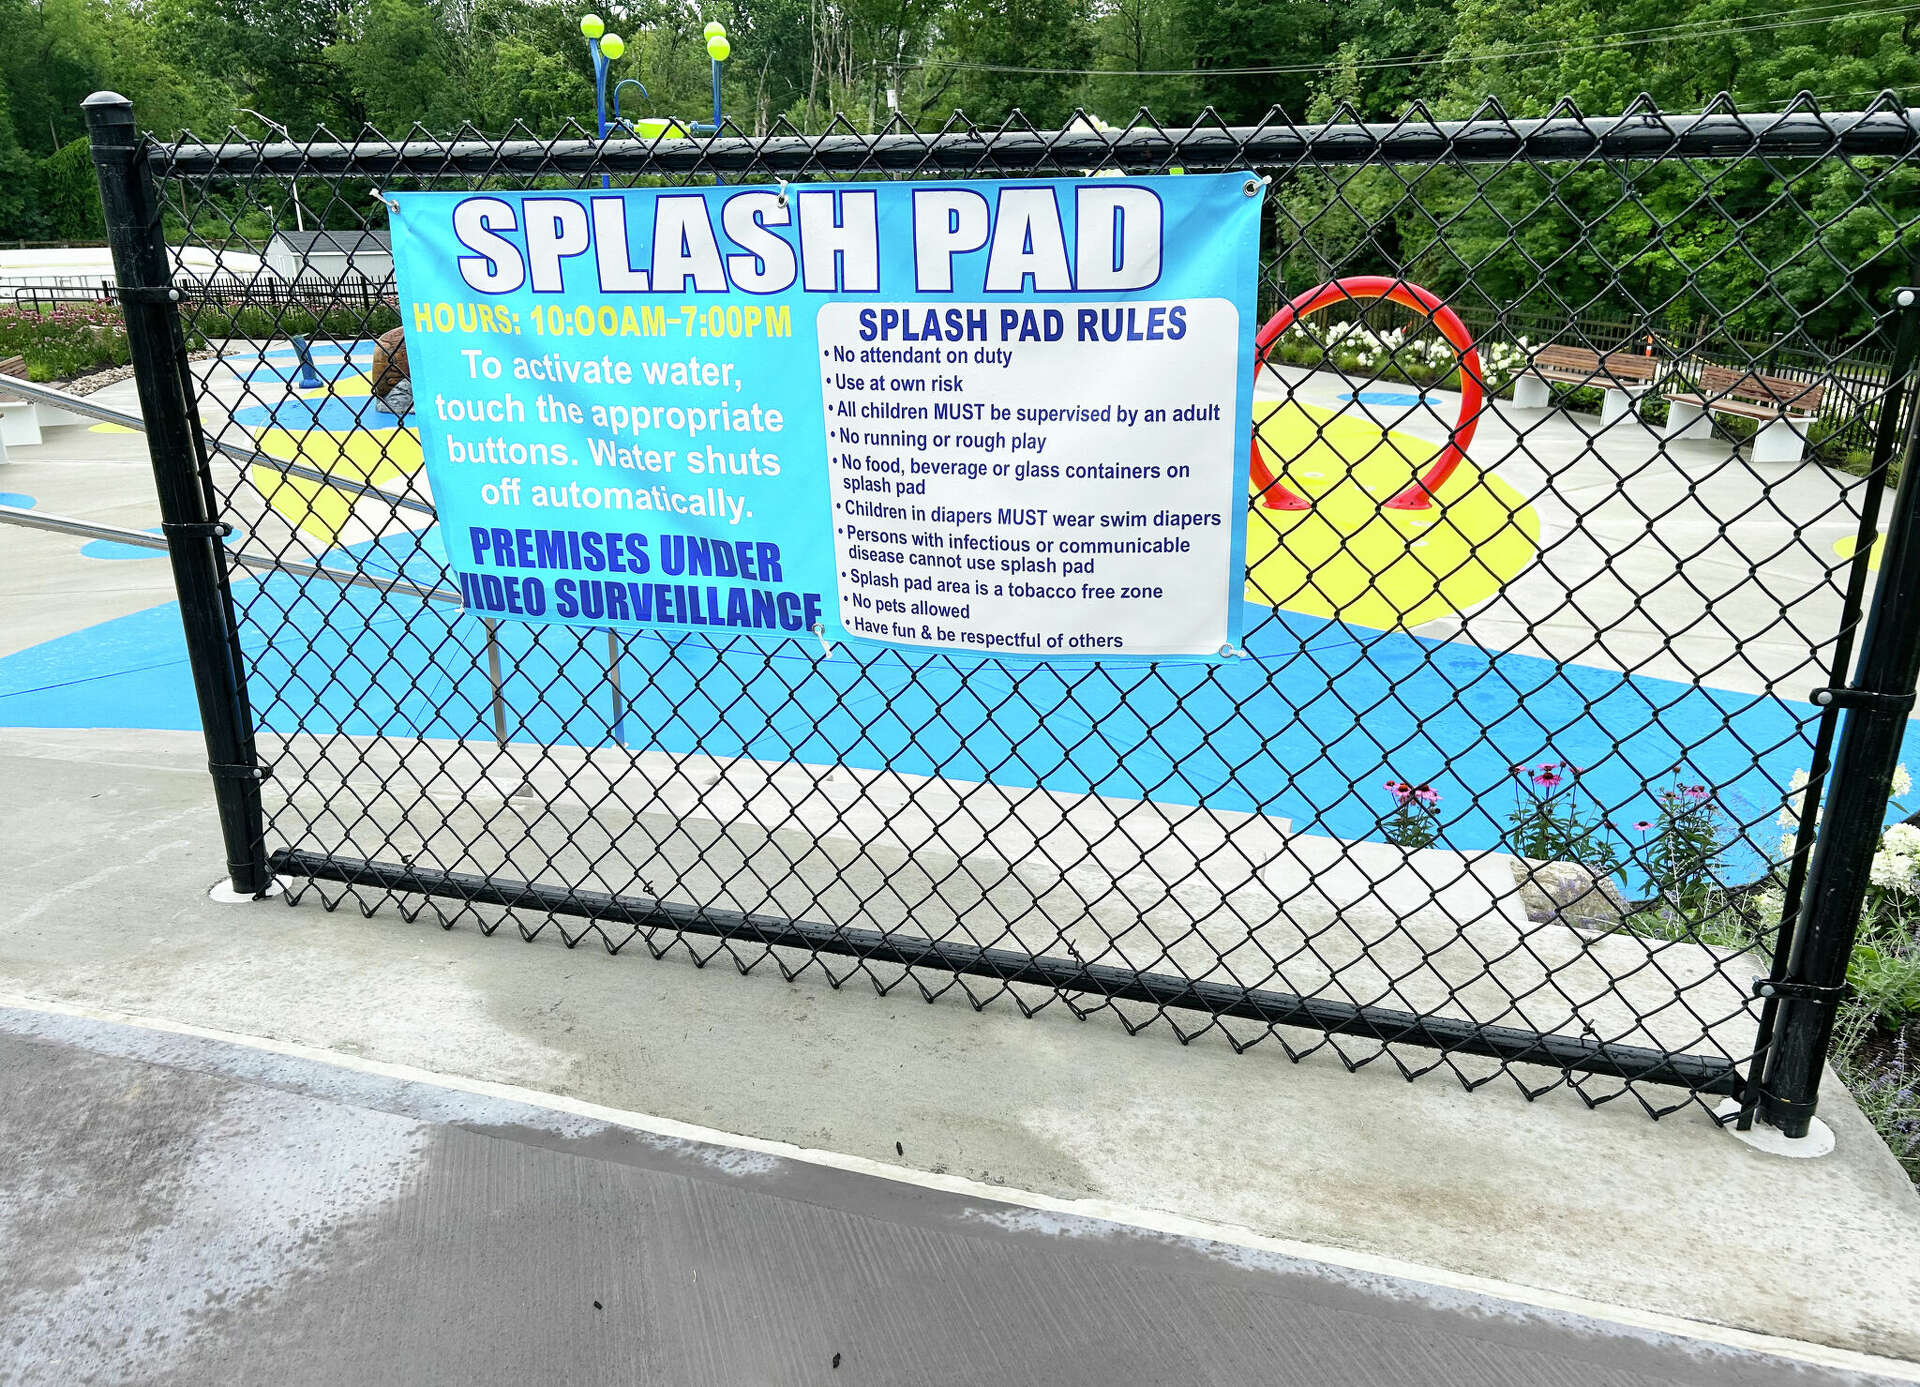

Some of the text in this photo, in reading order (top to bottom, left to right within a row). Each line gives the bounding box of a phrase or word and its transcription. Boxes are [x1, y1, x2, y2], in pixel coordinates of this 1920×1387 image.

[452, 185, 1164, 294] SPLASH PAD
[412, 303, 521, 334] HOURS:
[859, 305, 1187, 342] SPLASH PAD RULES
[460, 349, 742, 393] To activate water,
[833, 345, 1013, 369] No attendant on duty
[835, 373, 963, 392] Use at own risk
[434, 392, 784, 438] touch the appropriate
[837, 400, 1221, 427] All children MUST be supervised by an adult
[446, 434, 781, 477] buttons. Water shuts
[839, 427, 1047, 454] No running or rough play
[841, 453, 1190, 482] No food, beverage or glass containers on
[481, 477, 753, 525] off automatically.
[843, 475, 926, 498] splash pad
[845, 499, 1222, 530] Children in diapers MUST wear swim diapers
[469, 526, 783, 583] PREMISES UNDER
[847, 524, 1190, 554] Persons with infectious or communicable
[848, 544, 1095, 578] disease cannot use splash pad
[850, 568, 1163, 599] Splash pad area is a tobacco free zone
[554, 578, 822, 632] SURVEILLANCE
[852, 592, 970, 619] No pets allowed
[854, 616, 1123, 649] Have fun & be respectful of others
